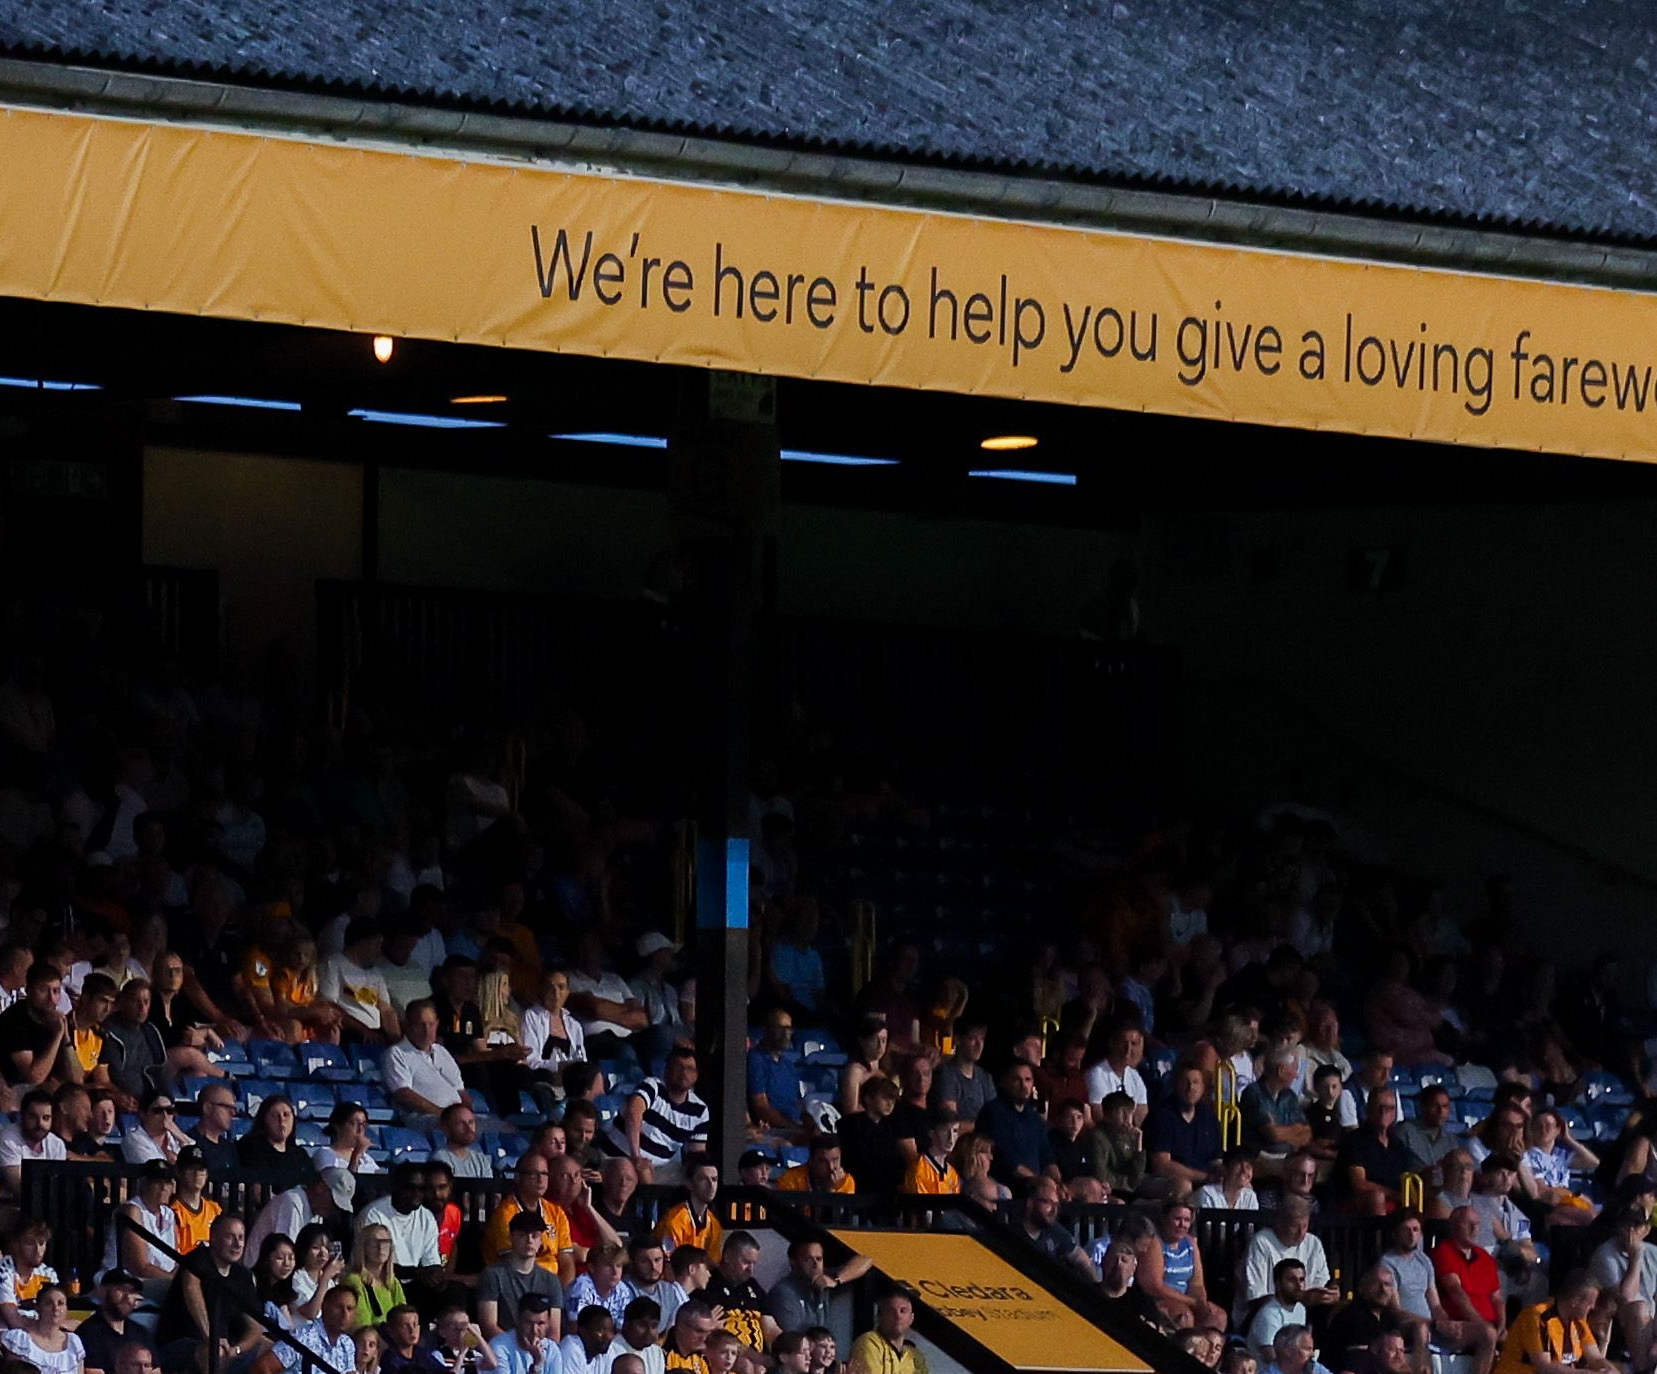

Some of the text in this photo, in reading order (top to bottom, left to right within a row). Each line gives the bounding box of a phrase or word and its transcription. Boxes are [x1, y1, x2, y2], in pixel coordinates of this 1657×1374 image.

[531, 224, 694, 313] We're
[713, 242, 837, 329] here
[855, 266, 910, 337] to
[928, 266, 1046, 368] help
[1059, 303, 1158, 374] you
[1176, 299, 1283, 387] give
[1298, 330, 1325, 381] a
[1344, 312, 1494, 416] loving
[918, 1279, 1032, 1303] Cledara
